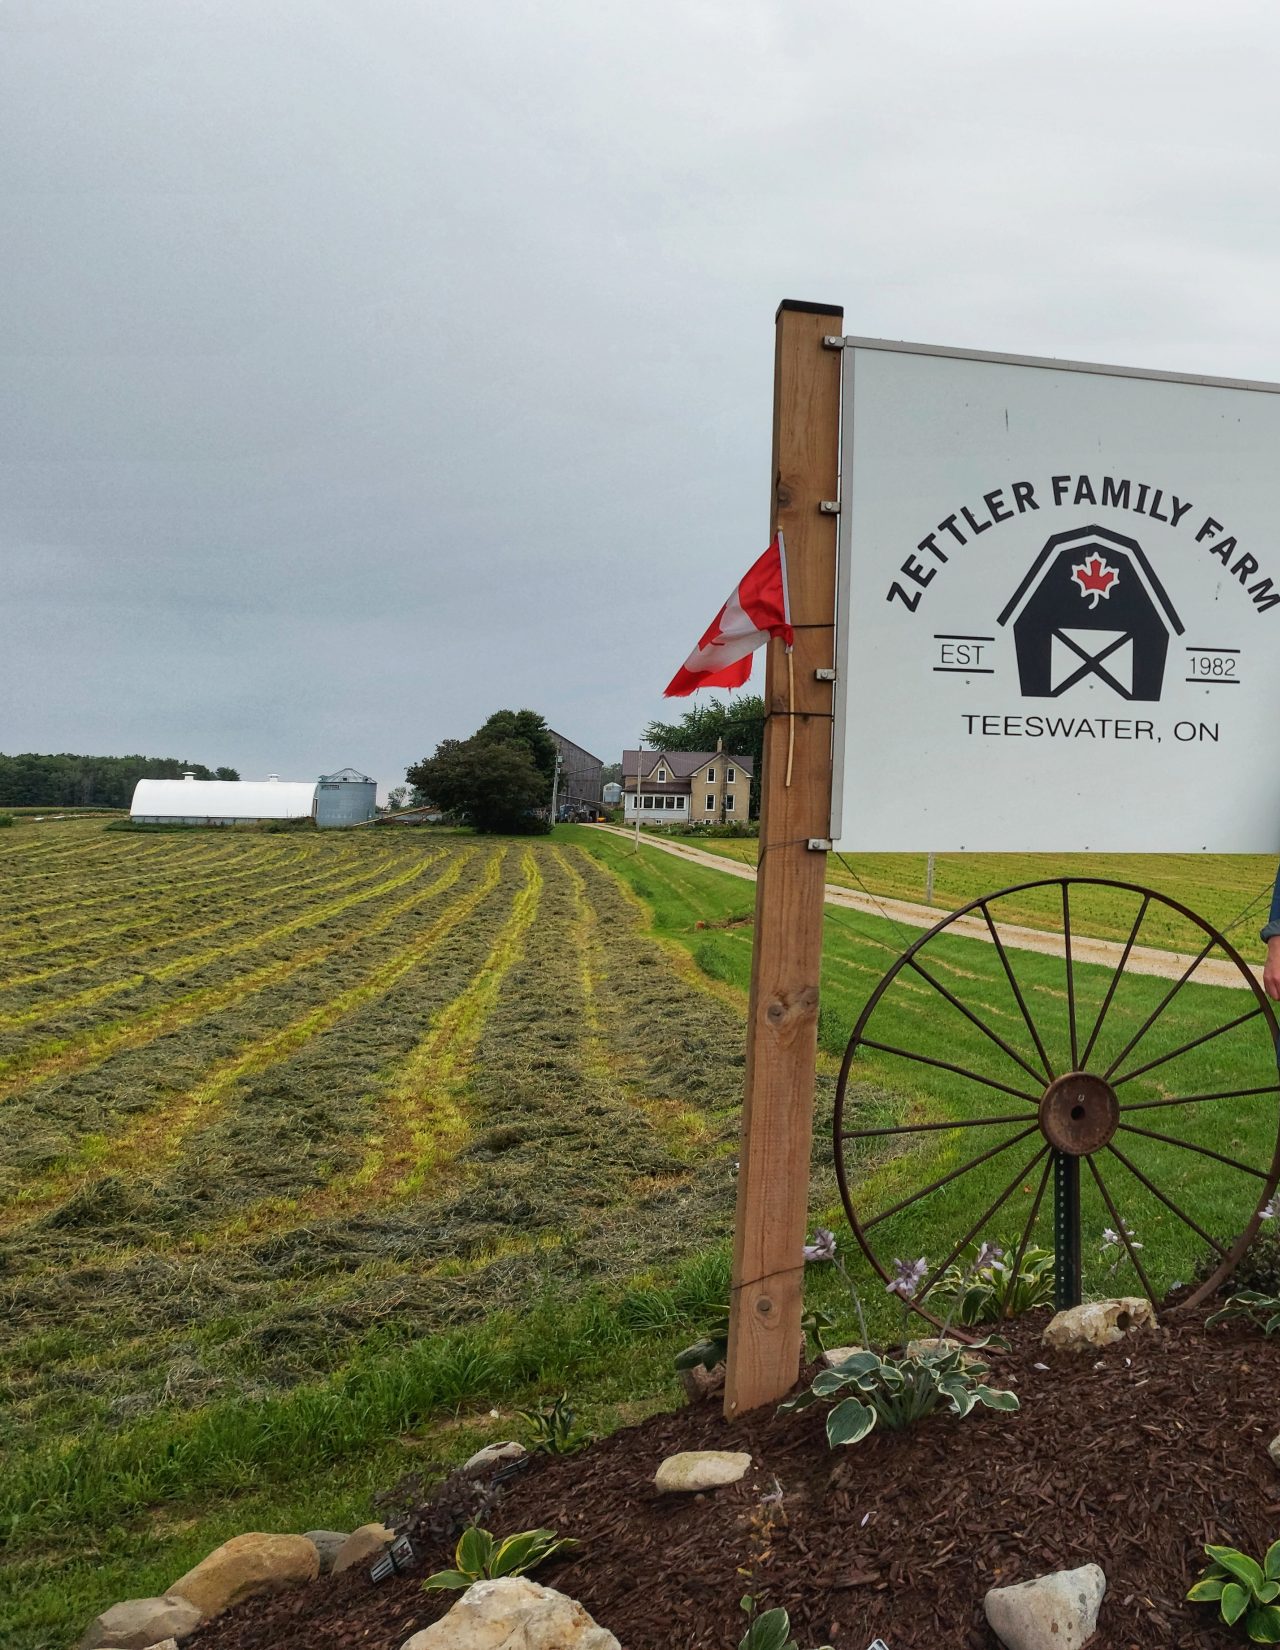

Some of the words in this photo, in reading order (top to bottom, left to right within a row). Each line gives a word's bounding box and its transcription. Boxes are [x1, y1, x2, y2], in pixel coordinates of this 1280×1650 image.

[885, 481, 1041, 613] ZETTLER
[1051, 474, 1194, 528] FAMILY
[940, 643, 985, 666] EST
[1189, 656, 1236, 678] 1982
[961, 714, 1162, 743] TEESWATER,
[1173, 721, 1220, 742] ON
